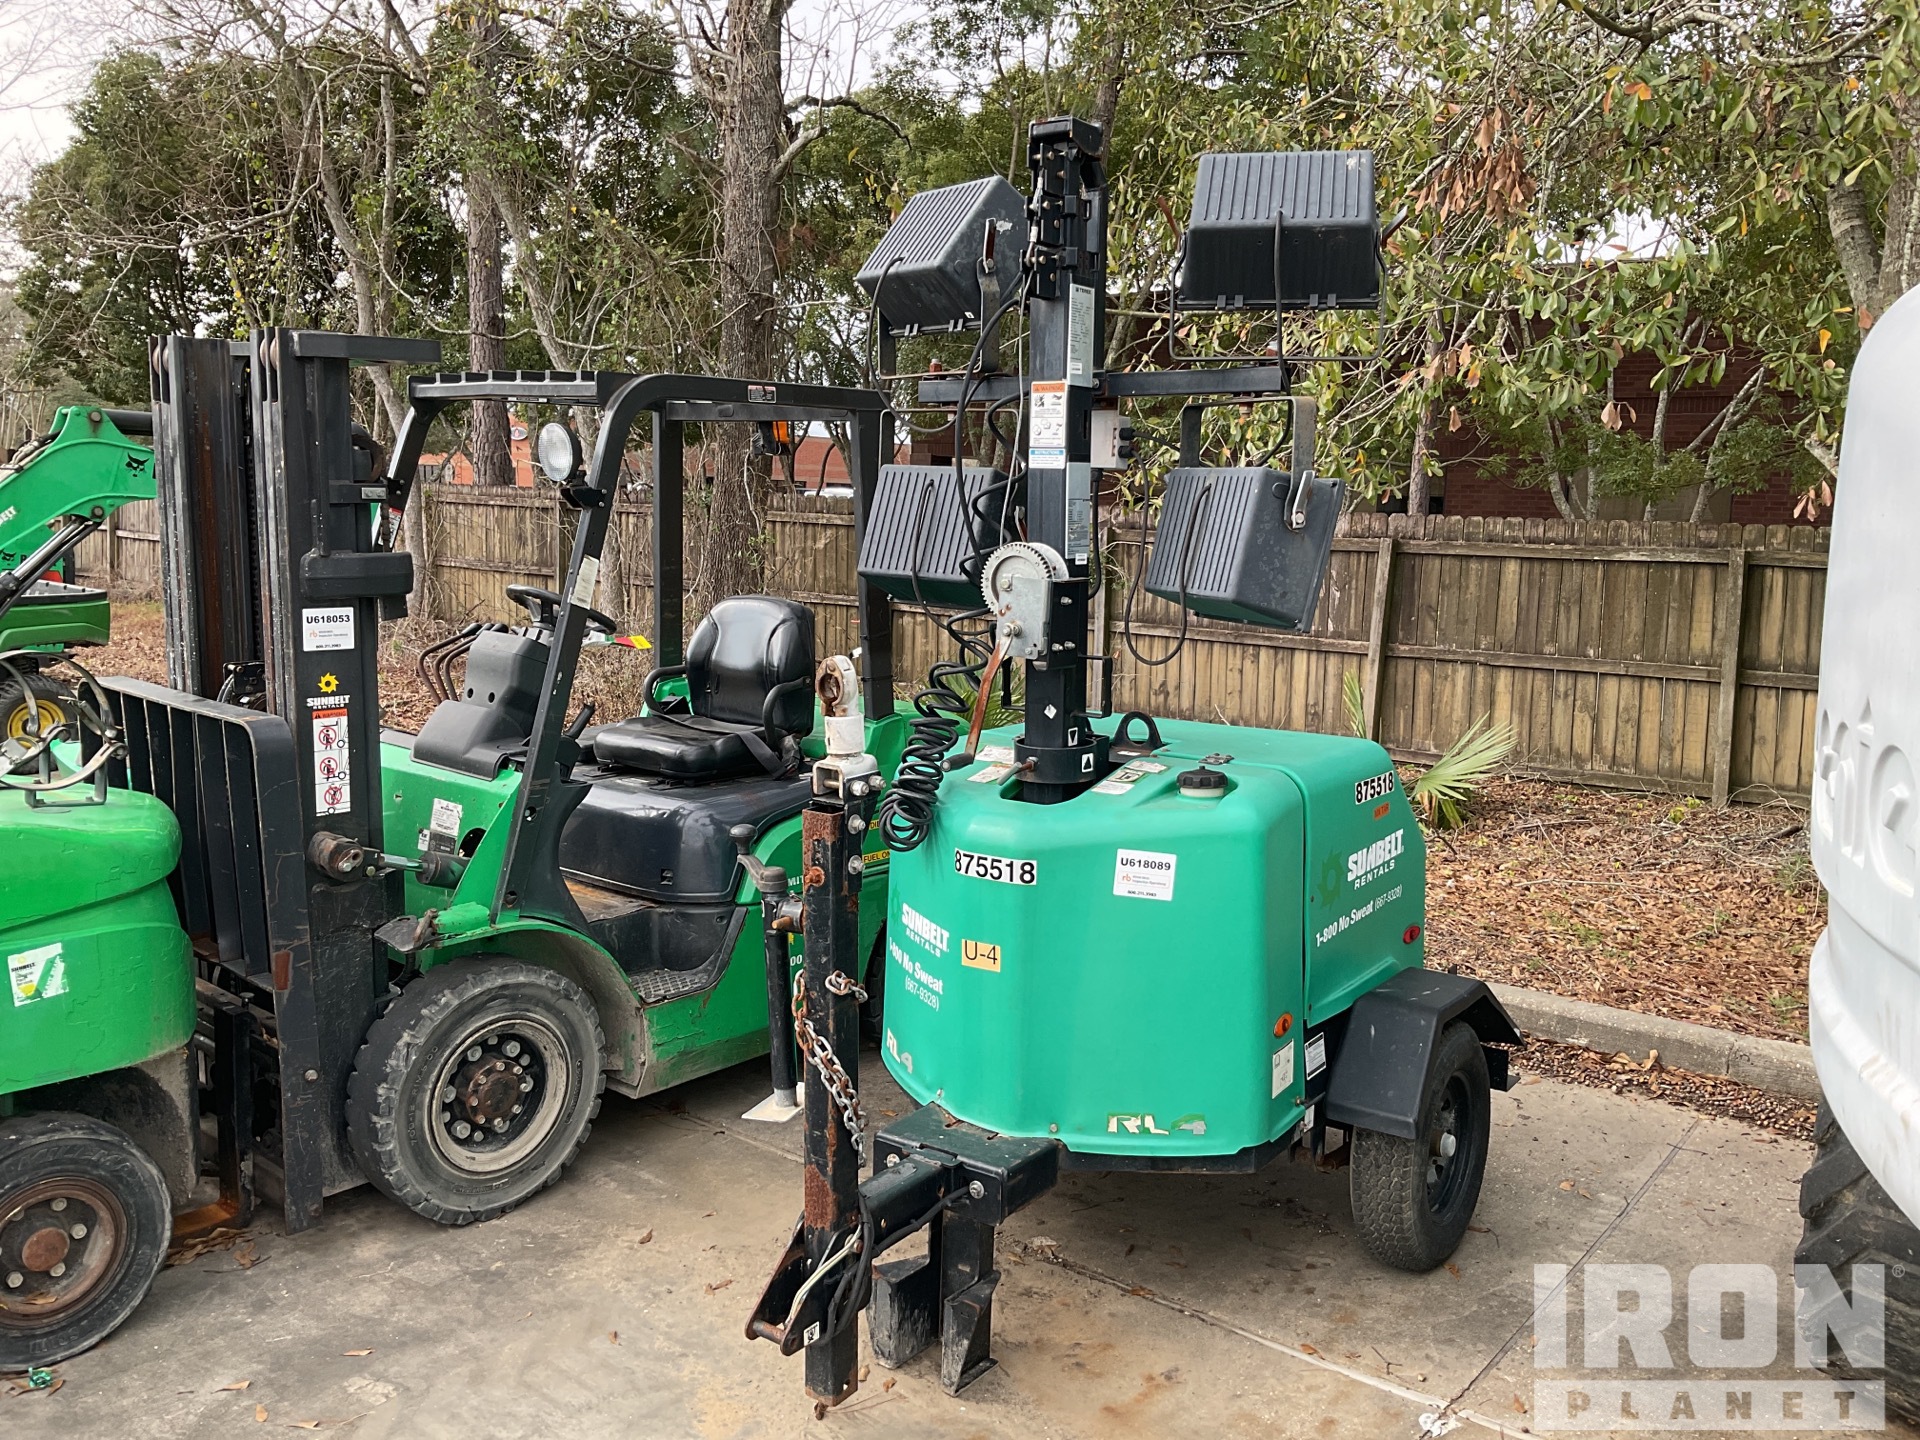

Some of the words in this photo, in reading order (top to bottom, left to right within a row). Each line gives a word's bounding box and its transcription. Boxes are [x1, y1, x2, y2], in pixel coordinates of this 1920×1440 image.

[306, 614, 351, 624] U618053
[306, 695, 351, 707] SUNBELT
[1356, 772, 1394, 803] 875518
[863, 853, 881, 863] FUEL
[955, 850, 1035, 885] 875518
[1120, 857, 1171, 871] U618089
[1347, 828, 1404, 882] SUNBELT
[1354, 859, 1395, 890] RENTALS
[902, 902, 950, 953] SUNBELT
[1316, 921, 1337, 947] 1-800
[1338, 915, 1350, 933] No
[1350, 900, 1373, 925] Sweat
[1374, 884, 1403, 911] (667-9328)
[906, 927, 941, 958] RENTALS
[965, 940, 998, 965] U-4
[902, 951, 914, 974] No
[914, 961, 944, 995] Sweat
[905, 974, 940, 1012] (667-9328)
